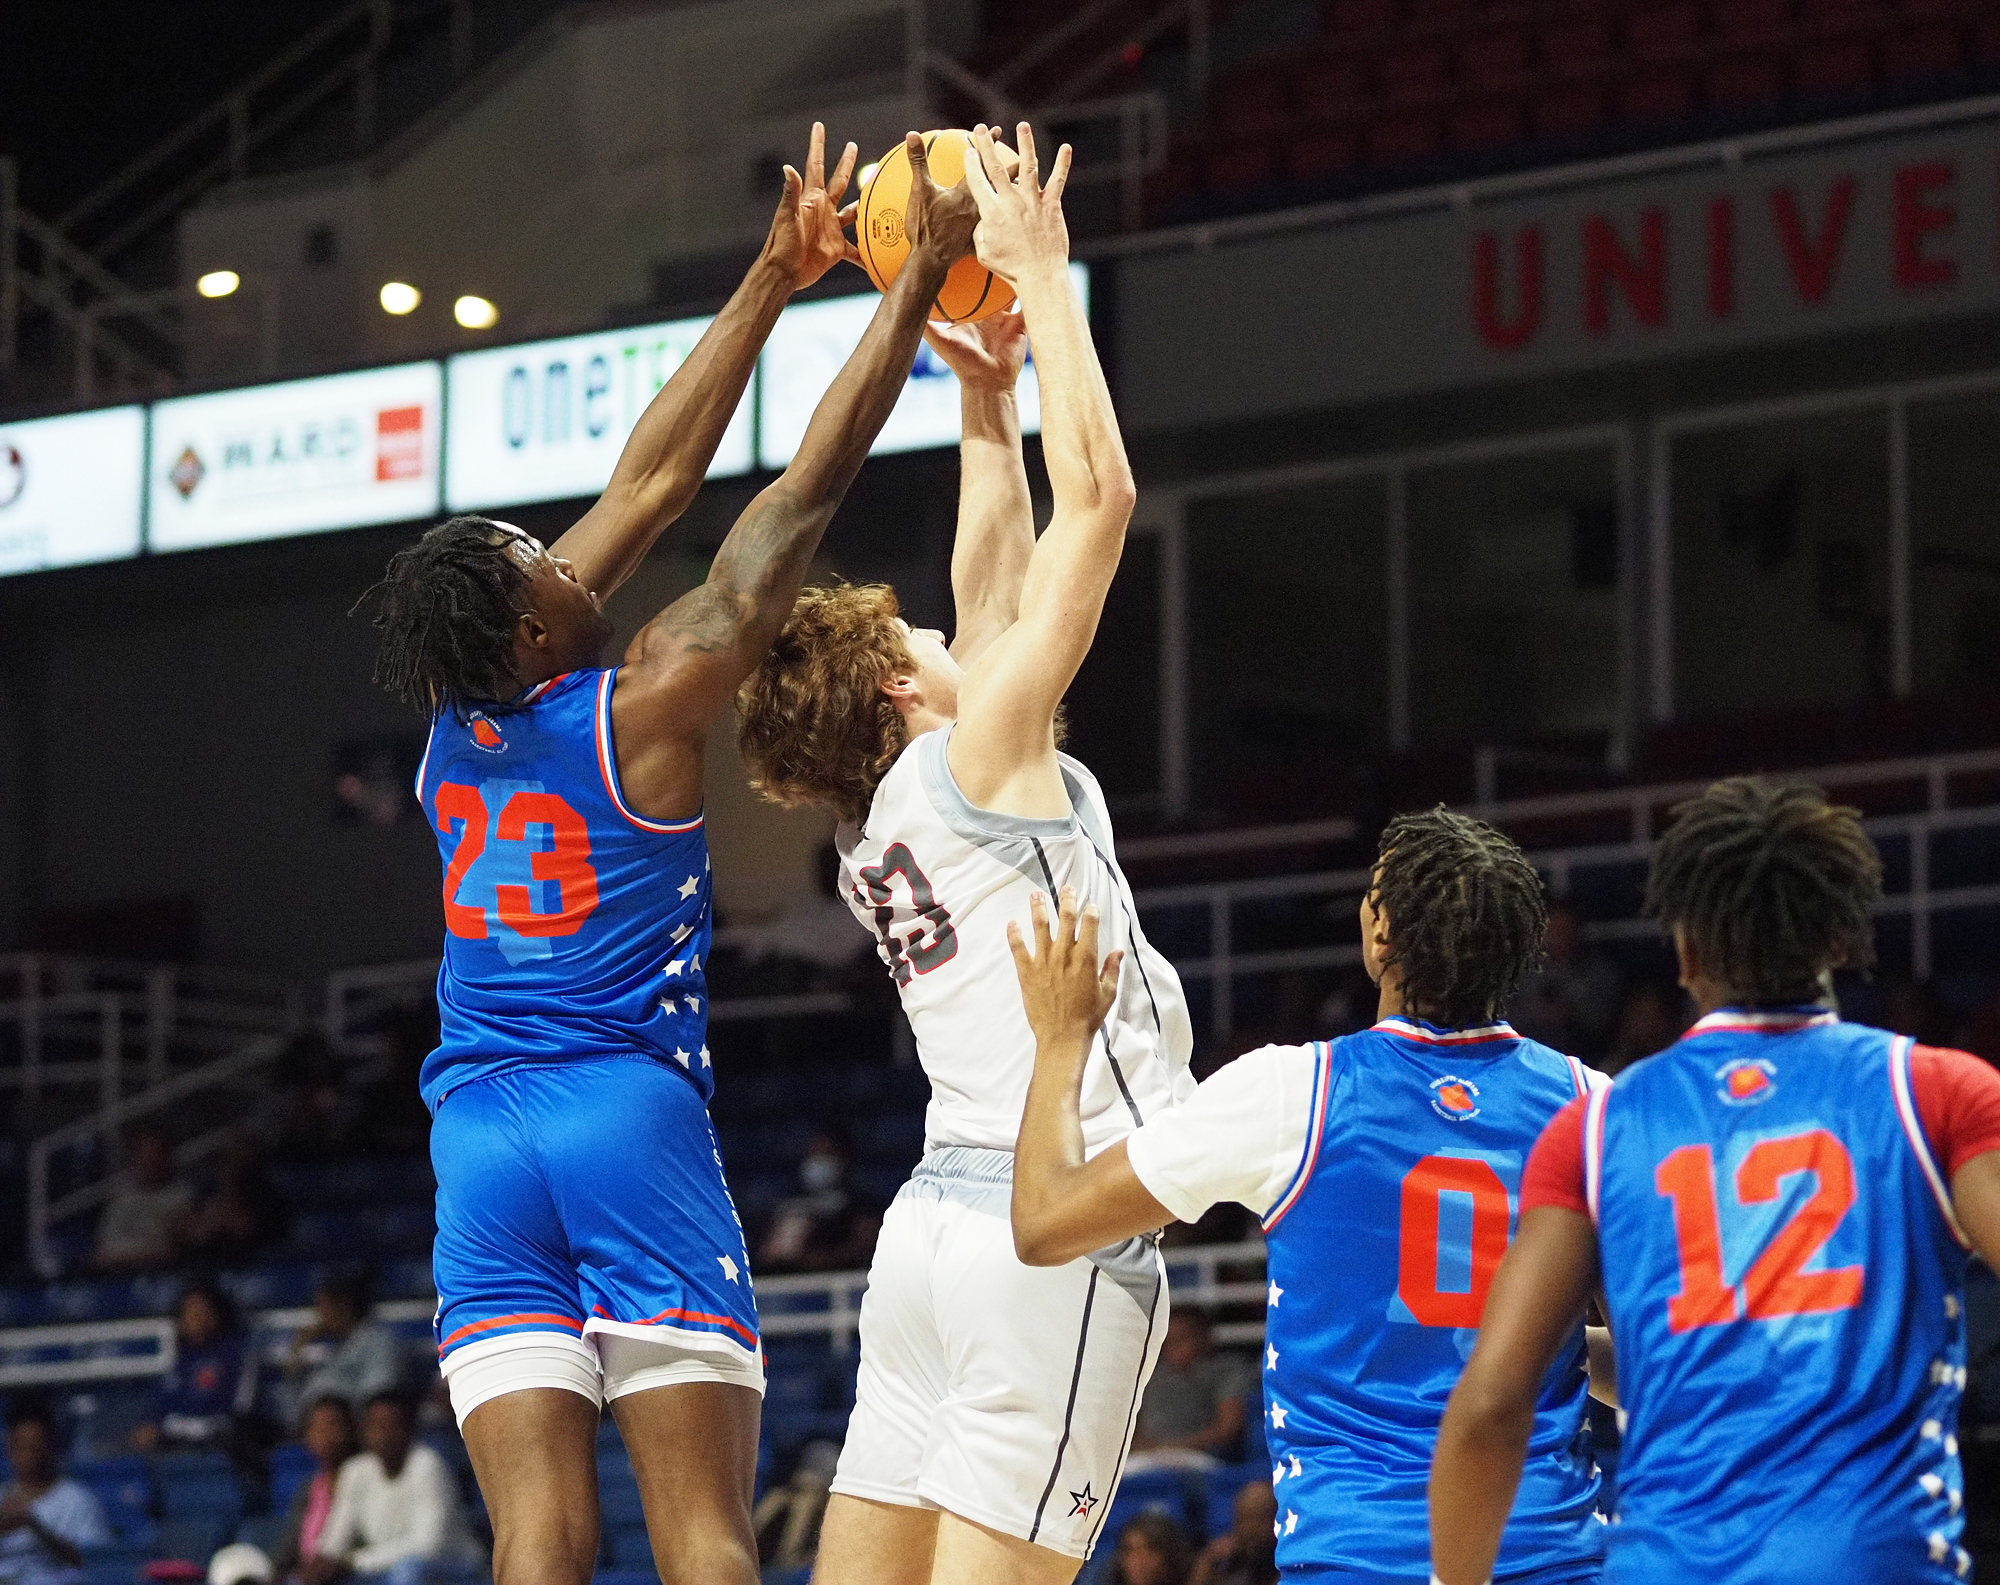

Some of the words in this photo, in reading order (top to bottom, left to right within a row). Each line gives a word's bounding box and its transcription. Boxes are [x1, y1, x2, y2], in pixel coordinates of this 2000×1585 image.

[1470, 159, 2000, 350] UNIVE
[434, 780, 599, 939] 23
[1398, 1155, 1509, 1328] 0
[1654, 1128, 1864, 1335] 12
